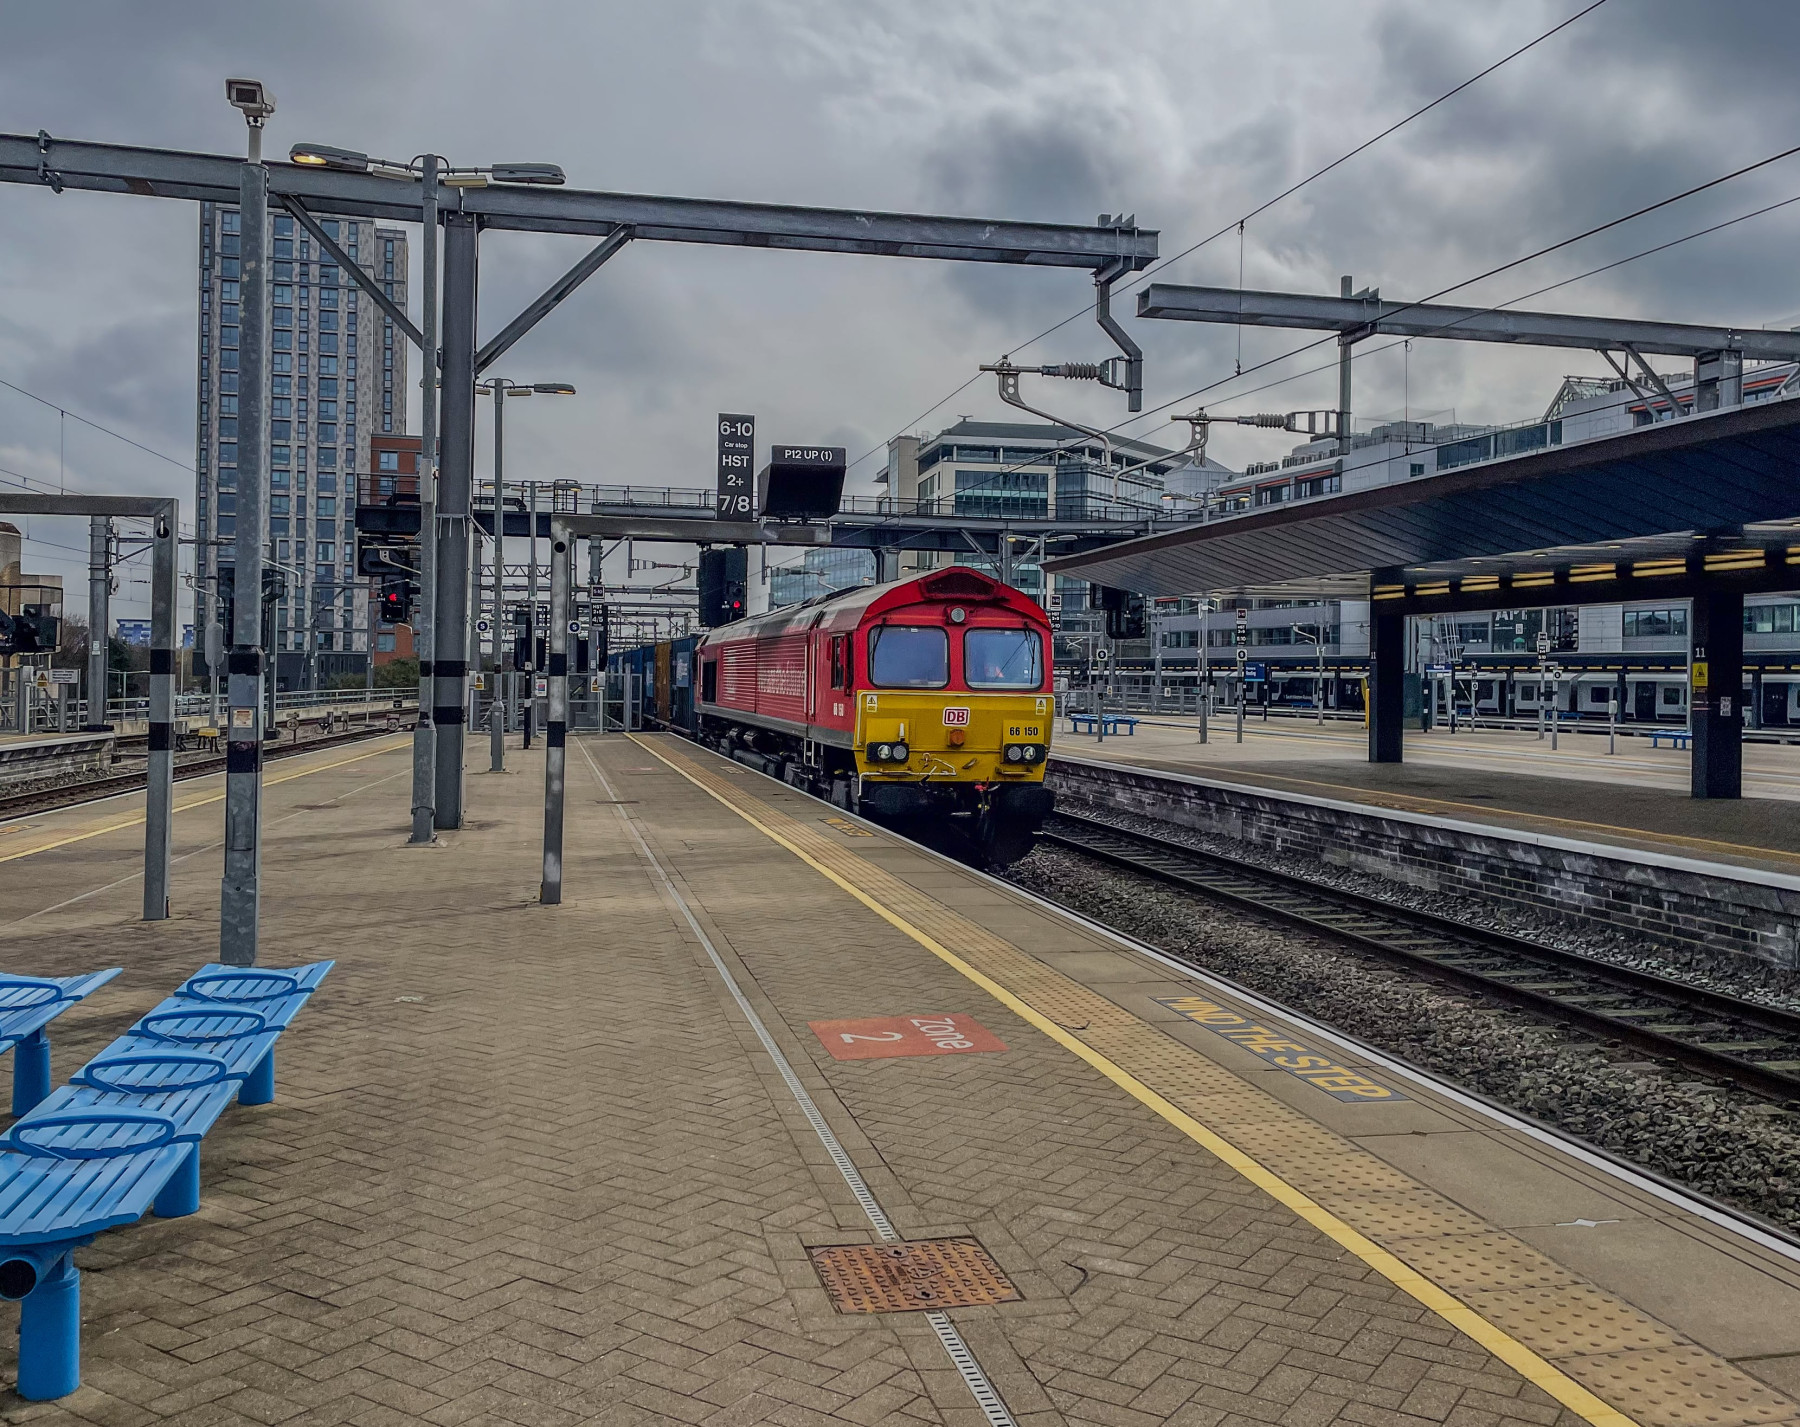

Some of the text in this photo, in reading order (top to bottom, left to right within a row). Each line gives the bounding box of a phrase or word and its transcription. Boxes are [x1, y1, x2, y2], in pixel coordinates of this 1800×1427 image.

[720, 421, 753, 437] 6-10
[722, 454, 750, 468] HST
[784, 449, 833, 462] P12 UP (1)
[727, 474, 745, 487] 2+
[719, 494, 750, 515] 7/8
[1695, 647, 1706, 658] 11
[946, 711, 966, 723] DB
[1009, 726, 1039, 737] 66 150
[840, 1031, 904, 1044] 2
[1156, 997, 1392, 1099] MIND THE STEP
